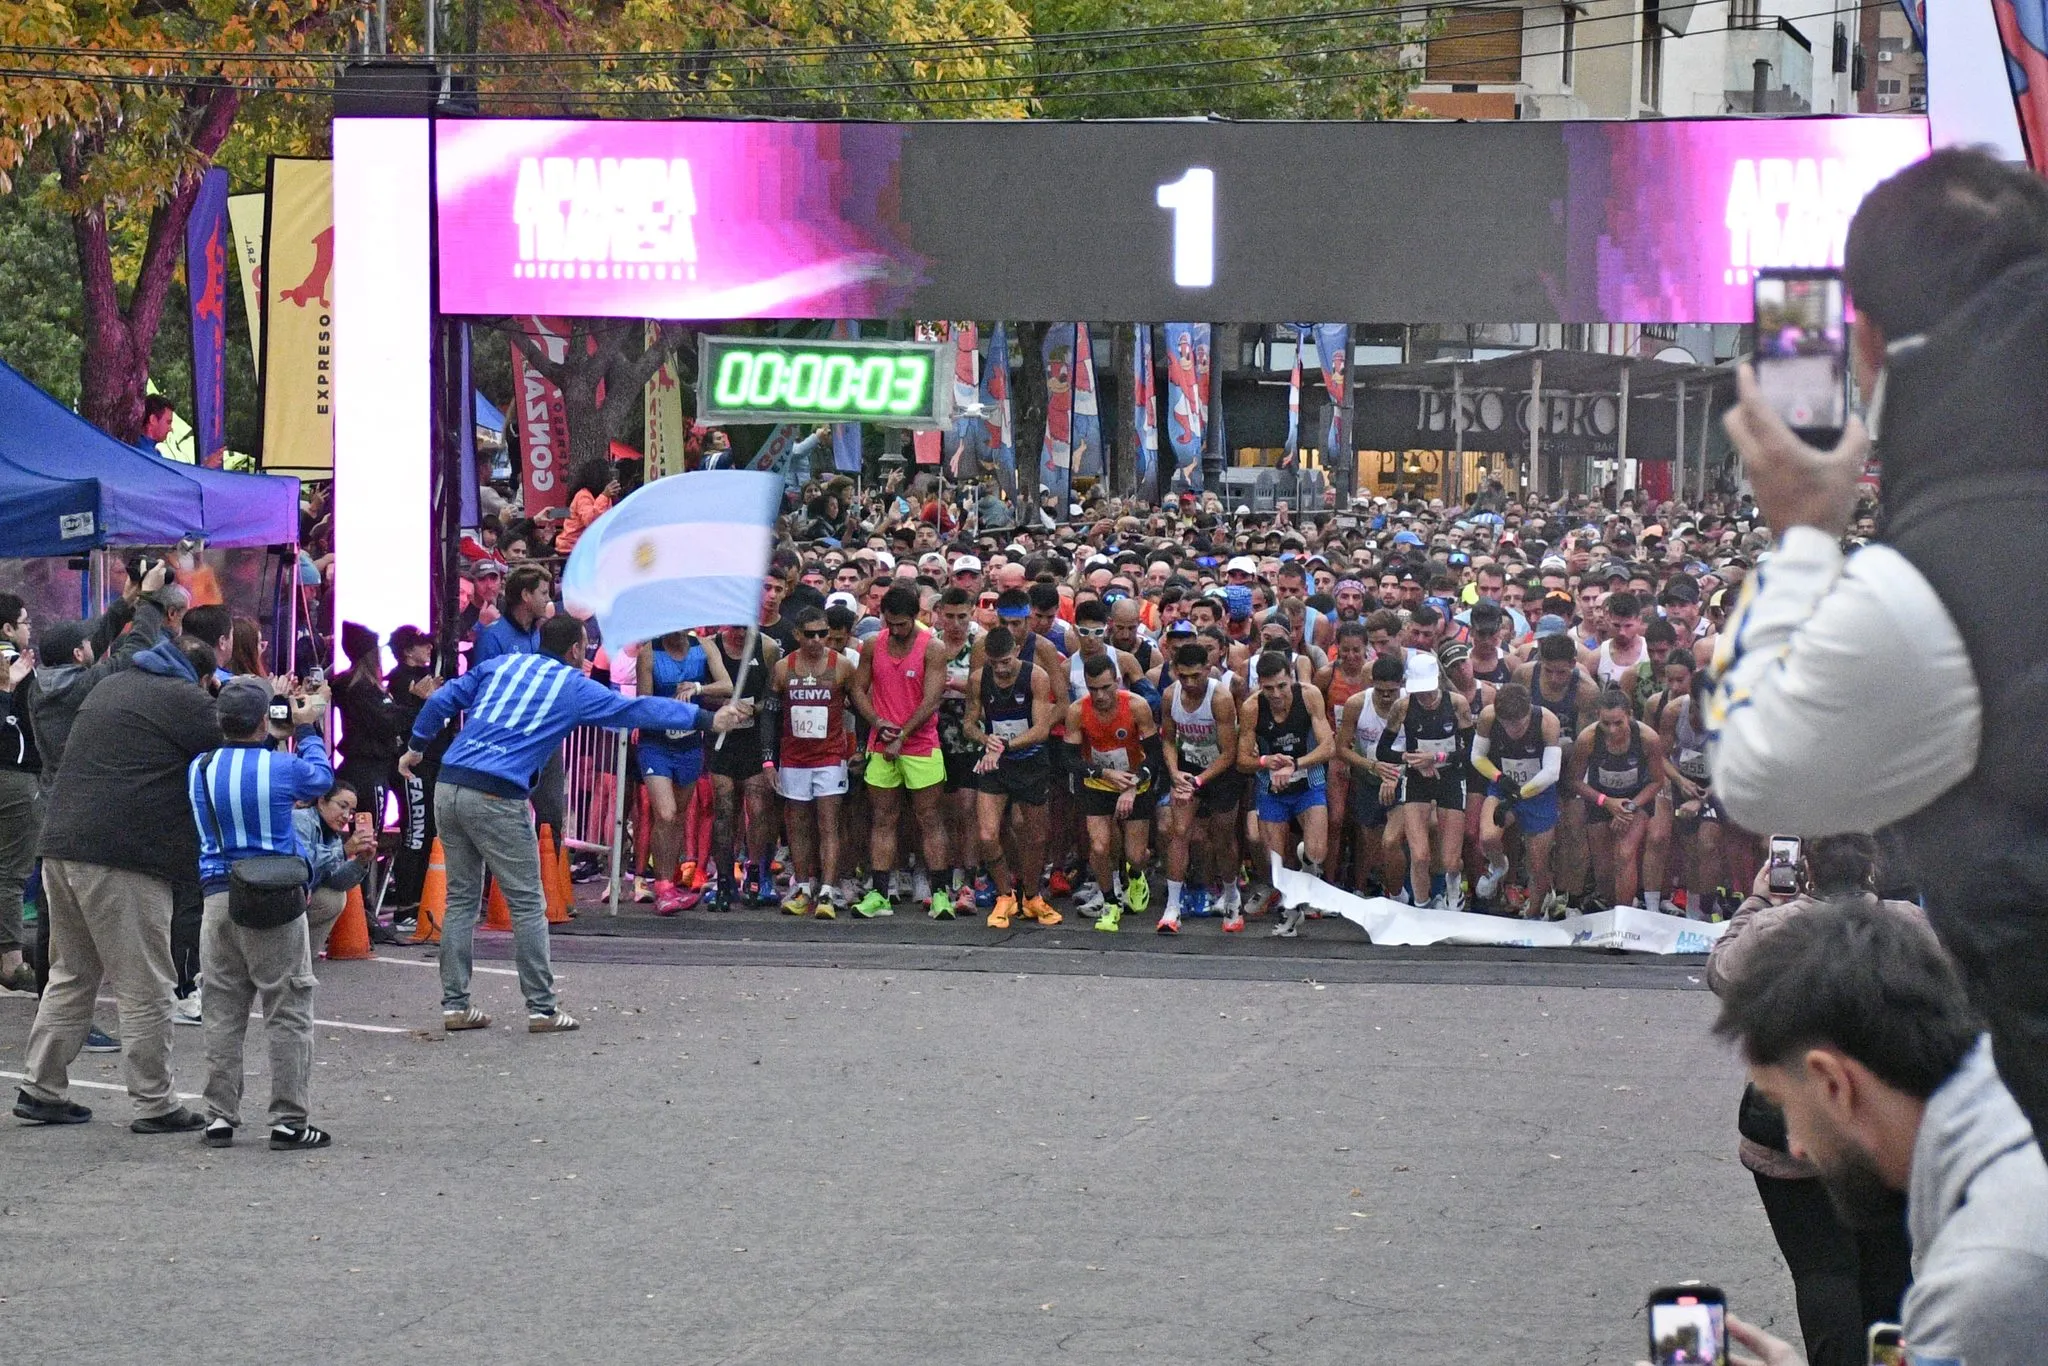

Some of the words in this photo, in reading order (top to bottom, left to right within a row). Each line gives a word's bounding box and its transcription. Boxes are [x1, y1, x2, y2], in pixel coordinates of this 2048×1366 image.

[1157, 168, 1213, 286] 1
[317, 314, 331, 415] EXPRESO
[716, 352, 927, 412] 00:00:03
[789, 689, 831, 700] KENYA
[793, 720, 813, 734] 142
[409, 777, 425, 850] FARINA
